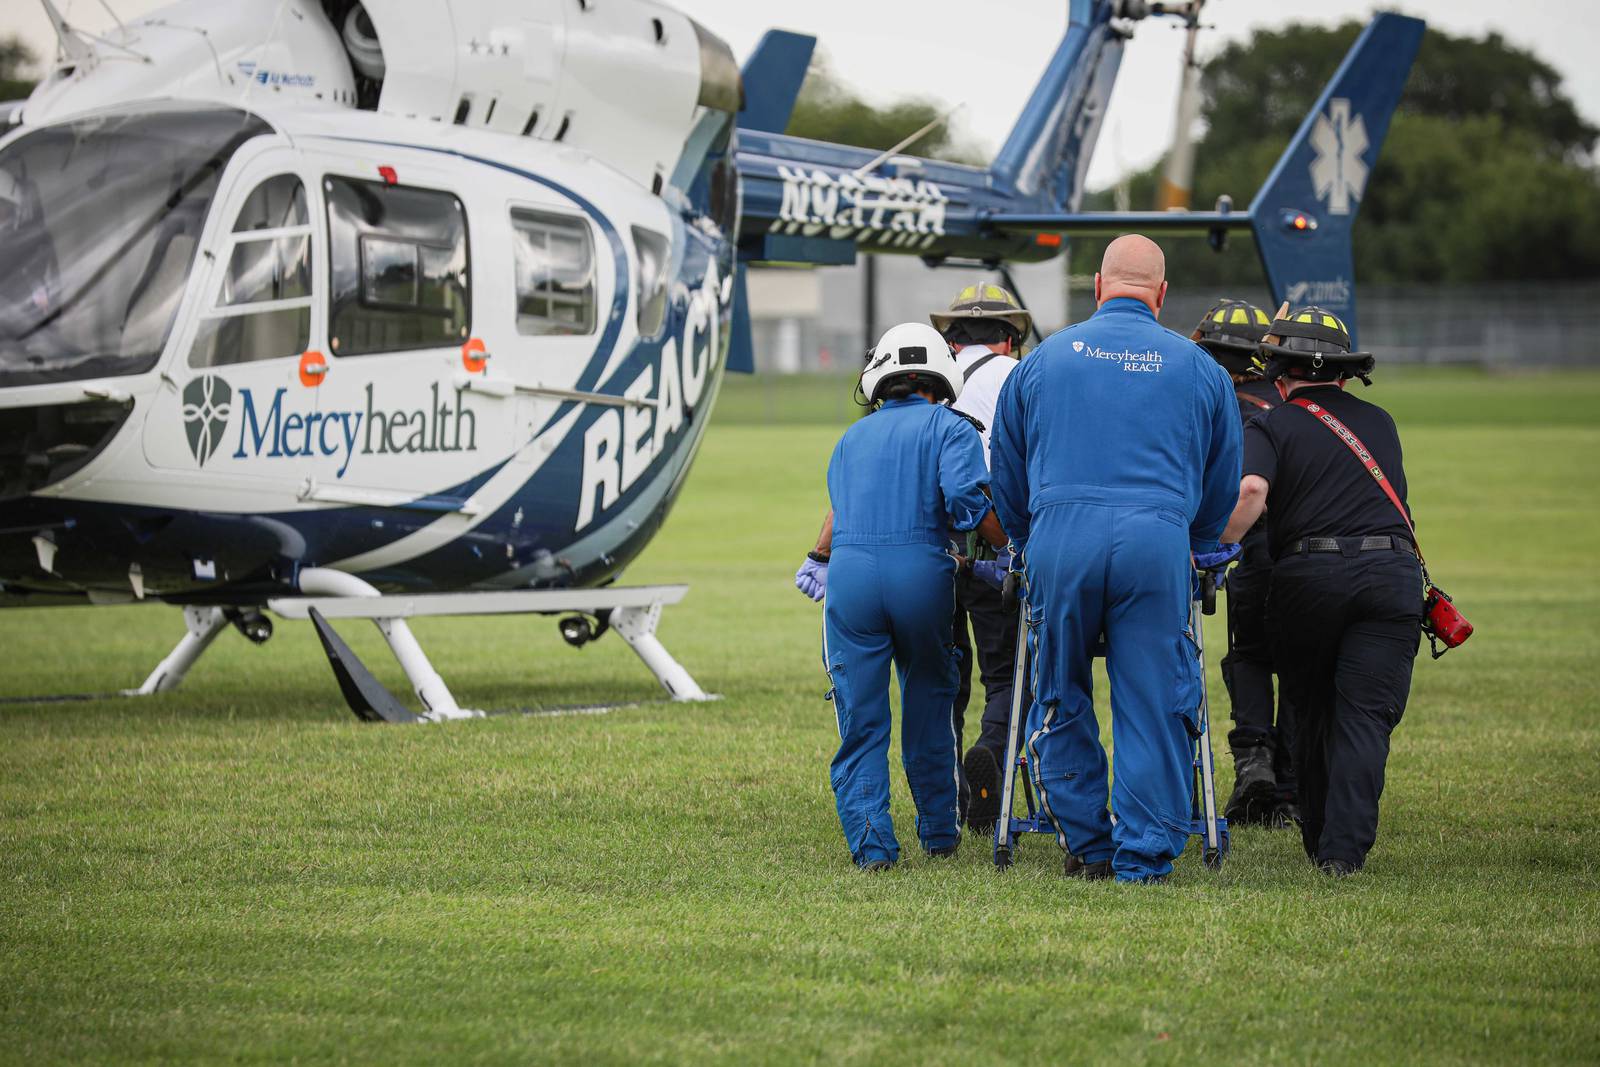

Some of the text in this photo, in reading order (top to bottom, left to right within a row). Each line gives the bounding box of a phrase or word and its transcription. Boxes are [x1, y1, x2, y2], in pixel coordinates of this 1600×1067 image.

[1085, 346, 1163, 364] Mercyhealth
[1123, 362, 1163, 373] REACT
[232, 380, 478, 479] Mercyhealth
